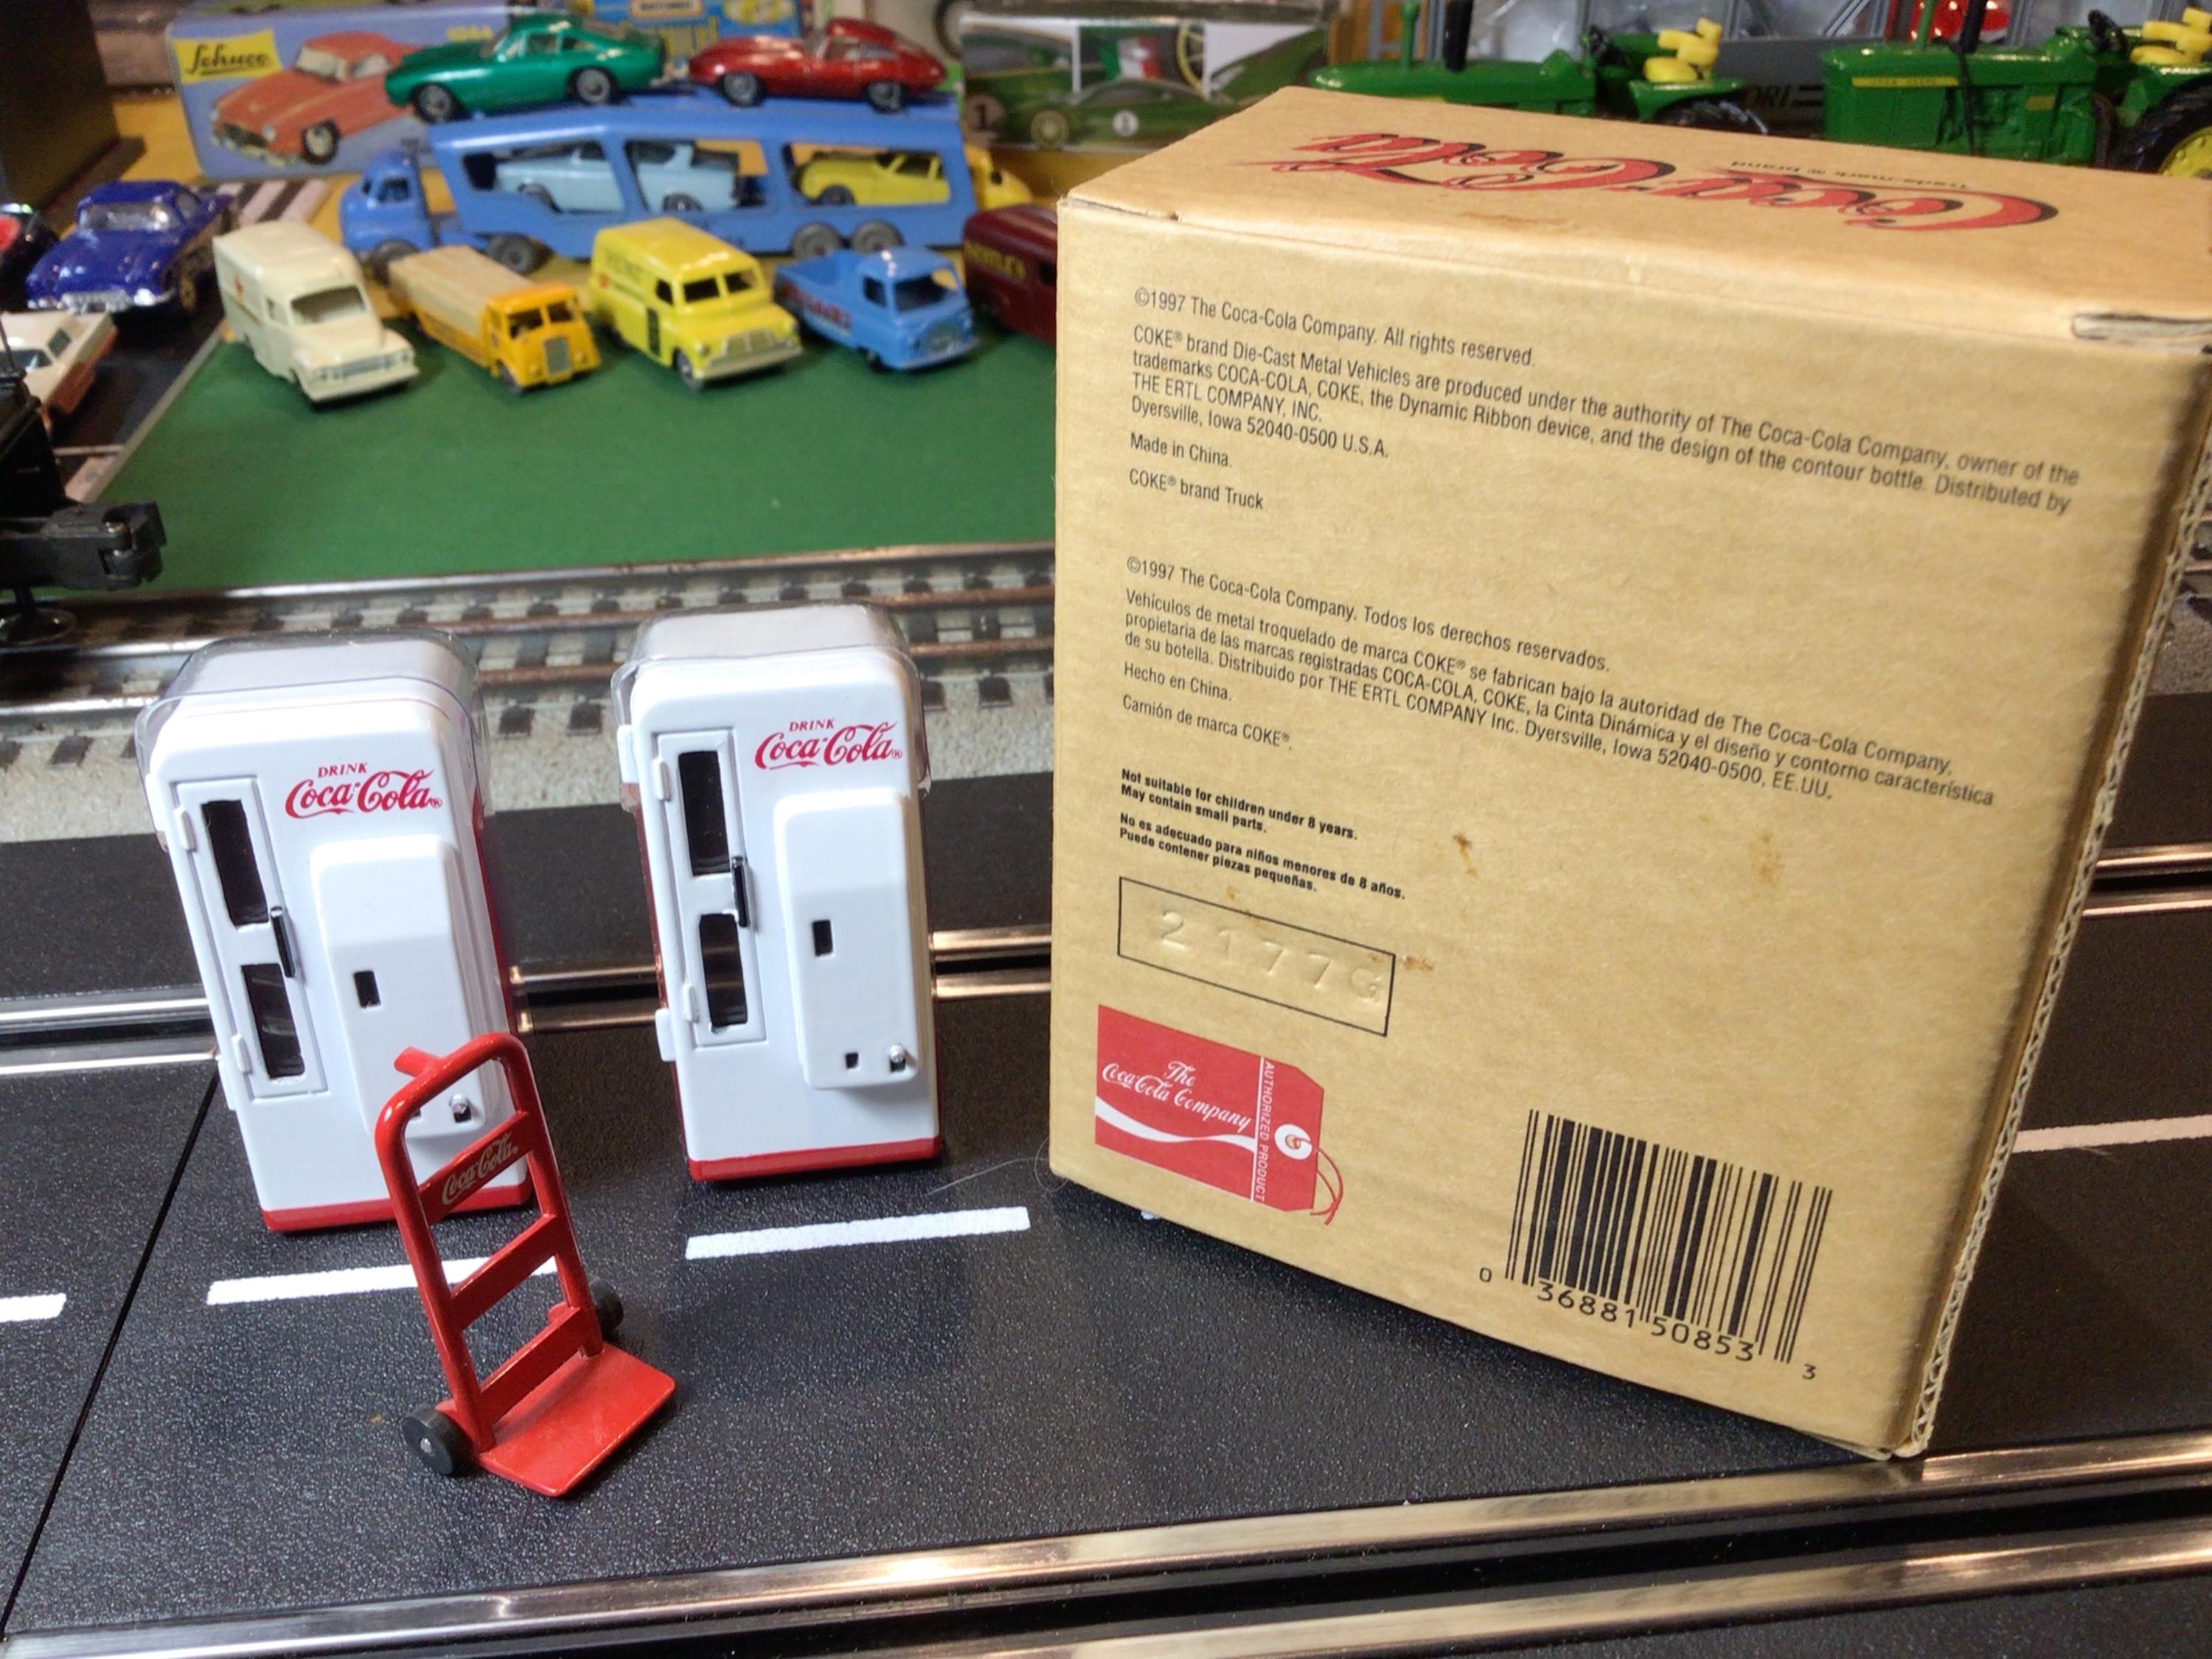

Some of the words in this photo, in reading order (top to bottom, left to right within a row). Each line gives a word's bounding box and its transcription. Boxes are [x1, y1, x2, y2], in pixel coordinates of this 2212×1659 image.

[1133, 287, 1186, 313] ©1997
[1190, 295, 1216, 318] The
[1220, 300, 1297, 331] Coca-Cola
[1301, 313, 1379, 346] Company.
[1382, 326, 1405, 347] All
[1408, 333, 1455, 355] rights
[1461, 341, 1535, 367] reserved.
[1131, 394, 1203, 427] Dyersville,
[1208, 408, 1242, 432] Iowa
[1246, 415, 1338, 449] 52040-0500
[1342, 432, 1388, 458] U.S.A.
[1132, 371, 1160, 392] THE
[1164, 377, 1201, 401] ERTL
[1206, 384, 1288, 416] COMPANY,
[1292, 400, 1322, 422] INC.
[1186, 333, 1228, 357] brand
[1232, 340, 1295, 369] Die-Cast
[1300, 351, 1342, 375] Metal
[1346, 359, 1411, 387] Vehicles
[1414, 373, 1440, 392] are
[1444, 378, 1523, 404] produced
[1527, 391, 1576, 411] under
[1581, 396, 1607, 417] the
[1612, 403, 1691, 433] authority
[1696, 413, 1715, 433] of
[1721, 414, 1752, 438] The
[1757, 420, 1851, 453] Coca-Cola
[1857, 434, 1948, 470] Company,
[1956, 453, 2017, 476] owner
[2023, 460, 2045, 479] of
[2048, 463, 2079, 485] the
[1130, 431, 1167, 455] Made
[1172, 440, 1184, 458] in
[1188, 443, 1232, 467] China.
[1133, 349, 1212, 378] trademarks
[1217, 362, 1312, 397] COCA-COLA,
[1316, 379, 1363, 406] COKE,
[1369, 388, 1394, 409] the
[1398, 392, 1468, 421] Dynamic
[1472, 404, 1531, 431] Ribbon
[1536, 415, 1593, 443] device,
[1599, 428, 1632, 448] and
[1638, 431, 1665, 452] the
[1669, 436, 1729, 465] design
[1734, 446, 1753, 465] of
[1758, 449, 1786, 470] the
[1791, 456, 1865, 481] contour
[1868, 465, 1926, 493] bottle.
[1934, 474, 2042, 509] Distributed
[2045, 491, 2071, 516] by
[1180, 478, 1220, 501] brand
[1224, 486, 1262, 509] Truck
[1126, 555, 1175, 580] ©1997
[1180, 566, 1205, 588] The
[1208, 573, 1281, 604] Coca-Cola
[1285, 588, 1357, 622] Company.
[1363, 605, 1408, 630] Todos
[1411, 615, 1434, 636] los
[1439, 622, 1511, 652] derechos
[1516, 640, 1610, 672] reservados.
[1124, 661, 1166, 685] Hecho
[1169, 675, 1186, 690] en
[1189, 676, 1231, 701] China.
[1124, 612, 1196, 640] propietaria
[1199, 627, 1216, 644] de
[1220, 630, 1239, 650] las
[1243, 639, 1294, 662] marcas
[1298, 651, 1378, 681] registradas
[1382, 666, 1477, 703] COCA-COLA,
[1482, 687, 1530, 716] COKE,
[1535, 699, 1549, 717] la
[1554, 703, 1594, 727] Cinta
[1599, 711, 1675, 743] Dinámica
[1678, 733, 1690, 749] y
[1694, 733, 1710, 749] el
[1713, 736, 1770, 762] diseño
[1773, 751, 1787, 768] y
[1790, 754, 1870, 782] contorno
[1874, 771, 1994, 806] característica
[1125, 587, 1191, 616] Vehículos
[1195, 604, 1212, 622] de
[1216, 611, 1255, 630] metal
[1259, 618, 1336, 649] troquelado
[1340, 636, 1358, 654] de
[1362, 643, 1408, 664] marca
[1469, 666, 1487, 681] se
[1492, 667, 1555, 695] fabrican
[1559, 681, 1595, 706] bajo
[1599, 689, 1613, 707] la
[1618, 696, 1700, 725] autoridad
[1703, 710, 1725, 730] de
[1731, 714, 1762, 737] The
[1767, 721, 1858, 756] Coca-Cola
[1863, 740, 1954, 777] Company,
[789, 718, 835, 731] DRINK
[1121, 693, 1172, 720] Camión
[1175, 708, 1192, 726] de
[1196, 715, 1238, 736] marca
[1124, 630, 1140, 648] de
[1144, 637, 1161, 653] su
[1164, 639, 1213, 664] botella.
[1218, 650, 1295, 683] Distribuido
[1298, 672, 1324, 689] por
[1329, 675, 1357, 697] THE
[1361, 683, 1400, 708] ERTL
[1405, 692, 1487, 725] COMPANY
[1490, 712, 1518, 733] Inc.
[1524, 718, 1606, 754] Dyersville,
[1612, 737, 1652, 762] Iowa
[1657, 747, 1764, 787] 52040-0500,
[1771, 770, 1836, 803] EE.UU.
[318, 762, 367, 778] DRINK
[1120, 782, 1145, 802] May
[1148, 793, 1192, 813] contain
[1194, 805, 1228, 823] small
[1231, 814, 1267, 832] parts.
[1121, 768, 1141, 784] Not
[1144, 776, 1192, 797] suitable
[1194, 787, 1212, 802] for
[1214, 793, 1265, 816] children
[1267, 808, 1304, 826] under
[1307, 815, 1315, 829] 8
[1318, 821, 1357, 840] years.
[1119, 812, 1135, 827] No
[1138, 819, 1152, 832] es
[1154, 824, 1212, 848] adecuado
[1214, 840, 1242, 856] para
[1245, 848, 1279, 866] niños
[1282, 858, 1336, 881] menores
[1339, 872, 1355, 886] de
[1358, 876, 1367, 889] 8
[1370, 881, 1405, 900] años.
[1119, 827, 1155, 847] Puede
[1158, 840, 1210, 862] contener
[1211, 855, 1251, 874] piezas
[1253, 866, 1316, 891] pequeñas.
[1164, 1060, 1196, 1087] The
[1259, 1061, 1275, 1144] AUTHORIZED
[1174, 1088, 1252, 1133] Company
[1255, 1144, 1270, 1203] PRODUCT
[1478, 1267, 1492, 1283] 0
[1537, 1281, 1635, 1329] 36881
[1651, 1316, 1754, 1363] 50853
[1802, 1363, 1817, 1381] 3
